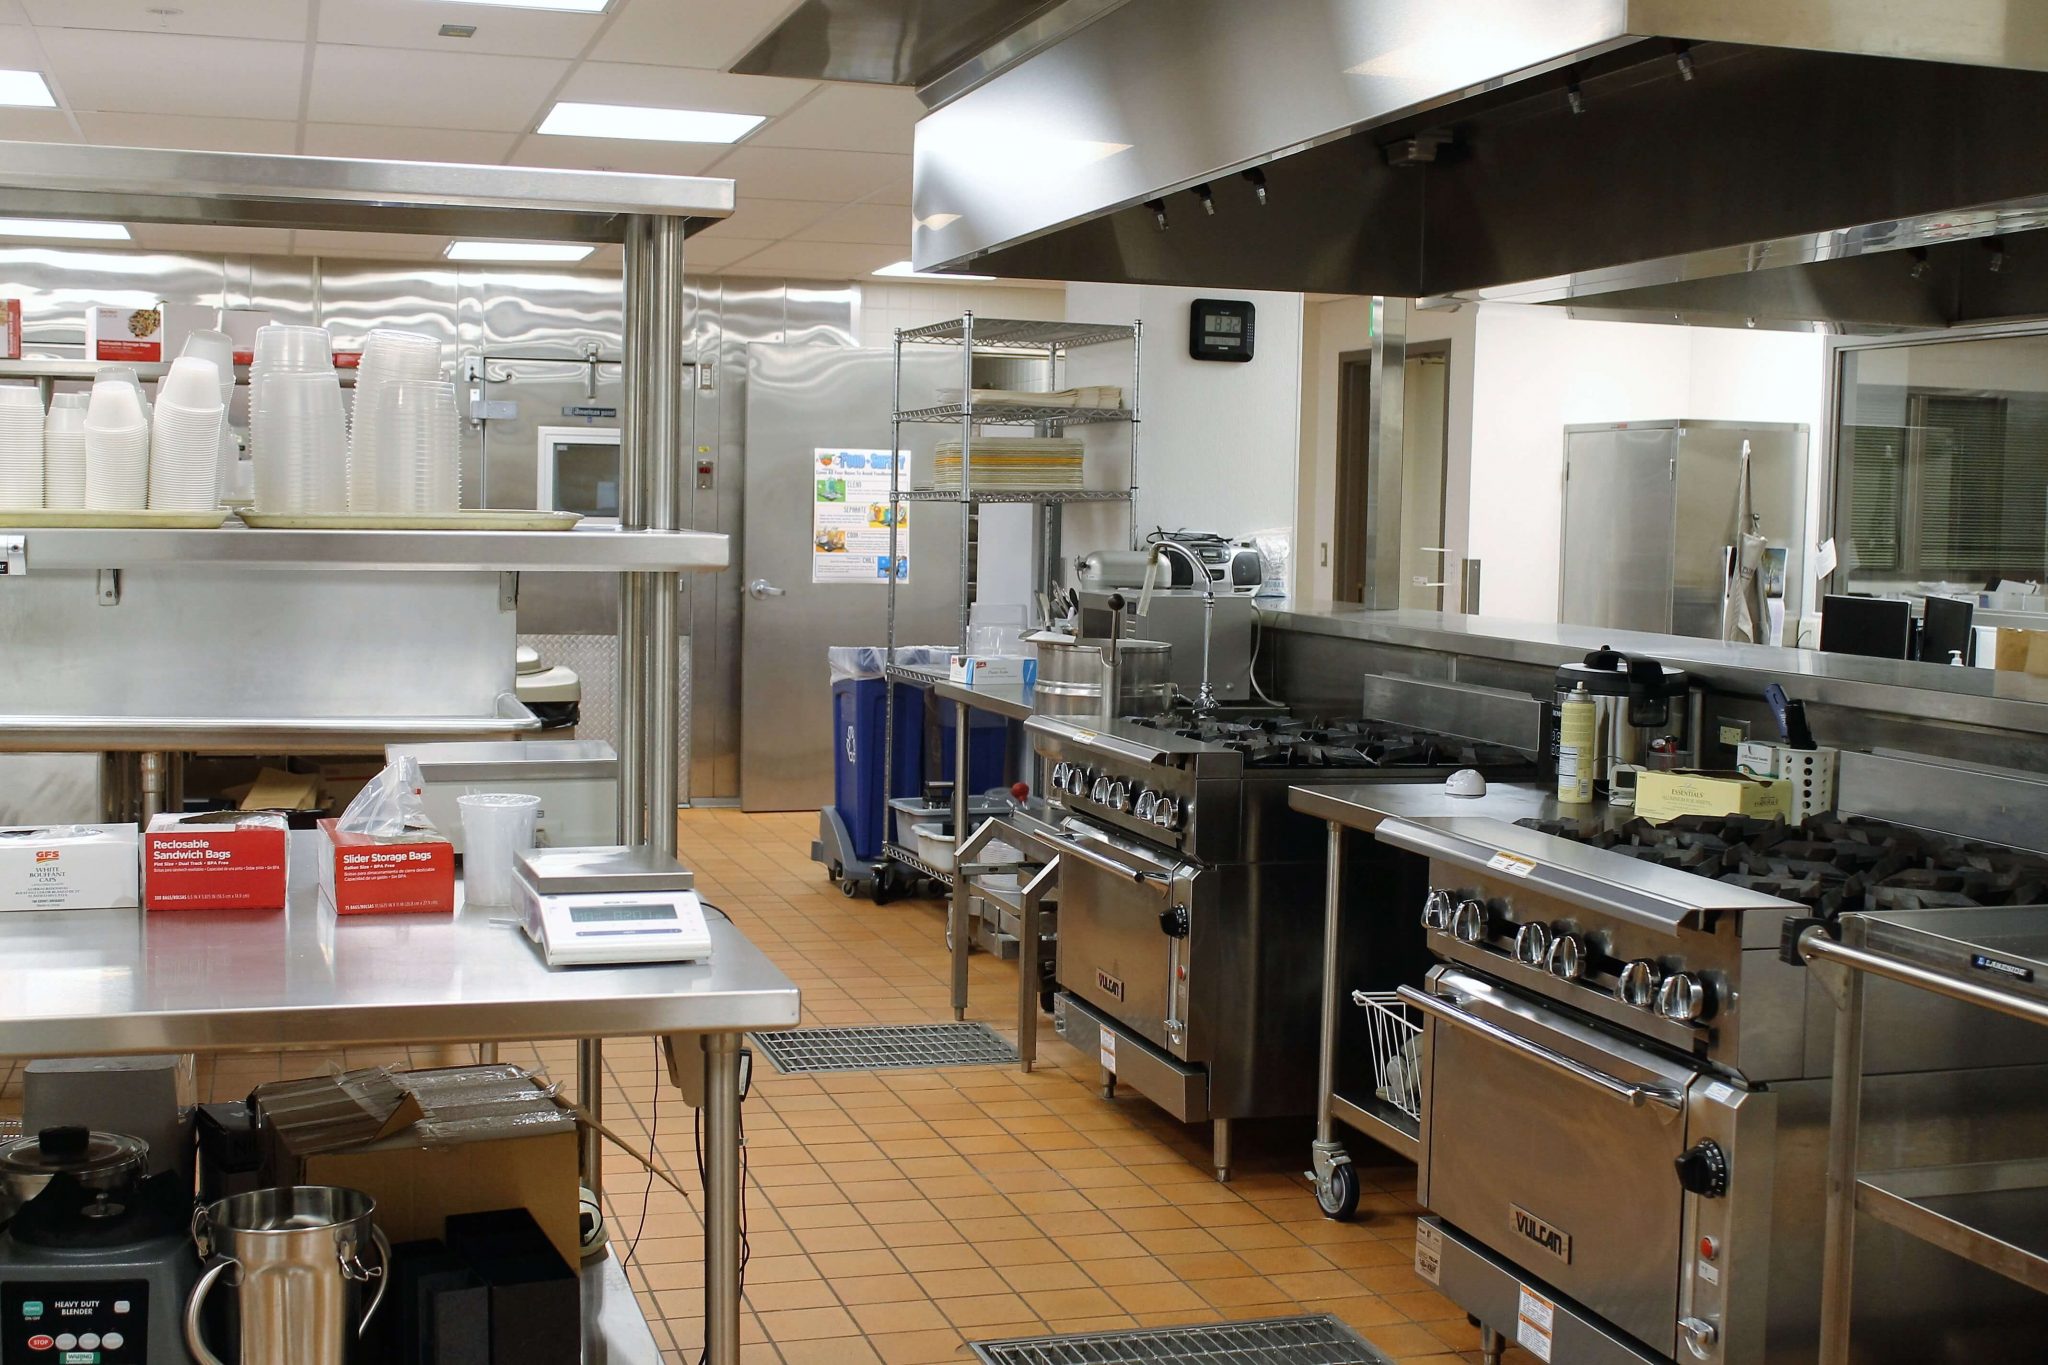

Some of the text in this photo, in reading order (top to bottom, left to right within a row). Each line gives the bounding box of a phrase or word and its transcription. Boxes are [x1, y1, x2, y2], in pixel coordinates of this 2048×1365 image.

[1671, 788, 1705, 799] ESSENTIALS
[153, 839, 210, 849] Reclosable
[36, 850, 60, 858] GFS
[153, 849, 231, 860] Sandwich Bags
[343, 851, 432, 864] Slider Storage Bags
[1098, 972, 1120, 997] VULCAN
[1515, 1211, 1562, 1256] VULCAN
[54, 1300, 100, 1308] HEAVY DUTY
[61, 1308, 93, 1316] BLENDER
